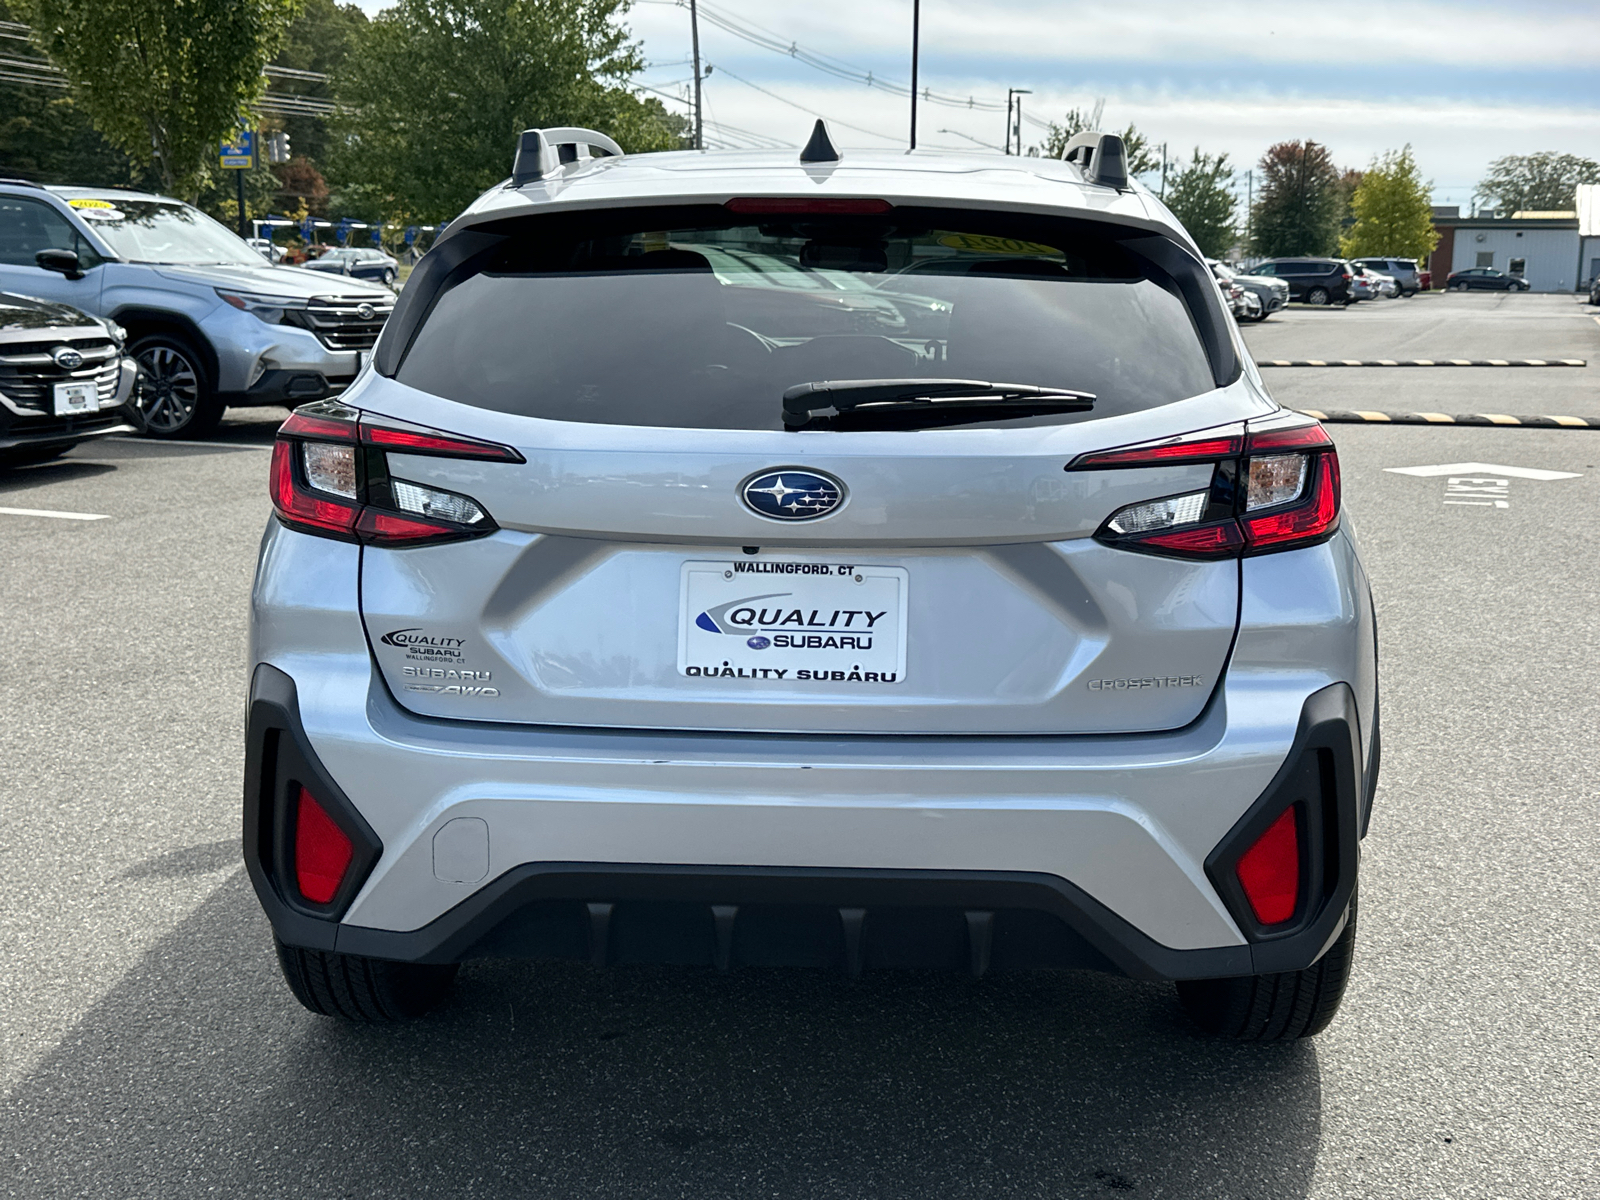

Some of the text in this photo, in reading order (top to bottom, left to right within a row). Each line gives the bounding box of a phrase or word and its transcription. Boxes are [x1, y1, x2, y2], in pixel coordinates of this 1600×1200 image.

[734, 562, 855, 576] WALLINGFORD, CT
[730, 607, 887, 628] QUALITY
[395, 633, 466, 647] QUALITY
[773, 635, 873, 650] SUBARU
[409, 647, 461, 658] SUBARU
[402, 666, 492, 681] SUBARU
[685, 665, 897, 683] QUALITY SUBARU
[1087, 675, 1205, 691] CROSSTREK
[440, 685, 501, 697] AWD
